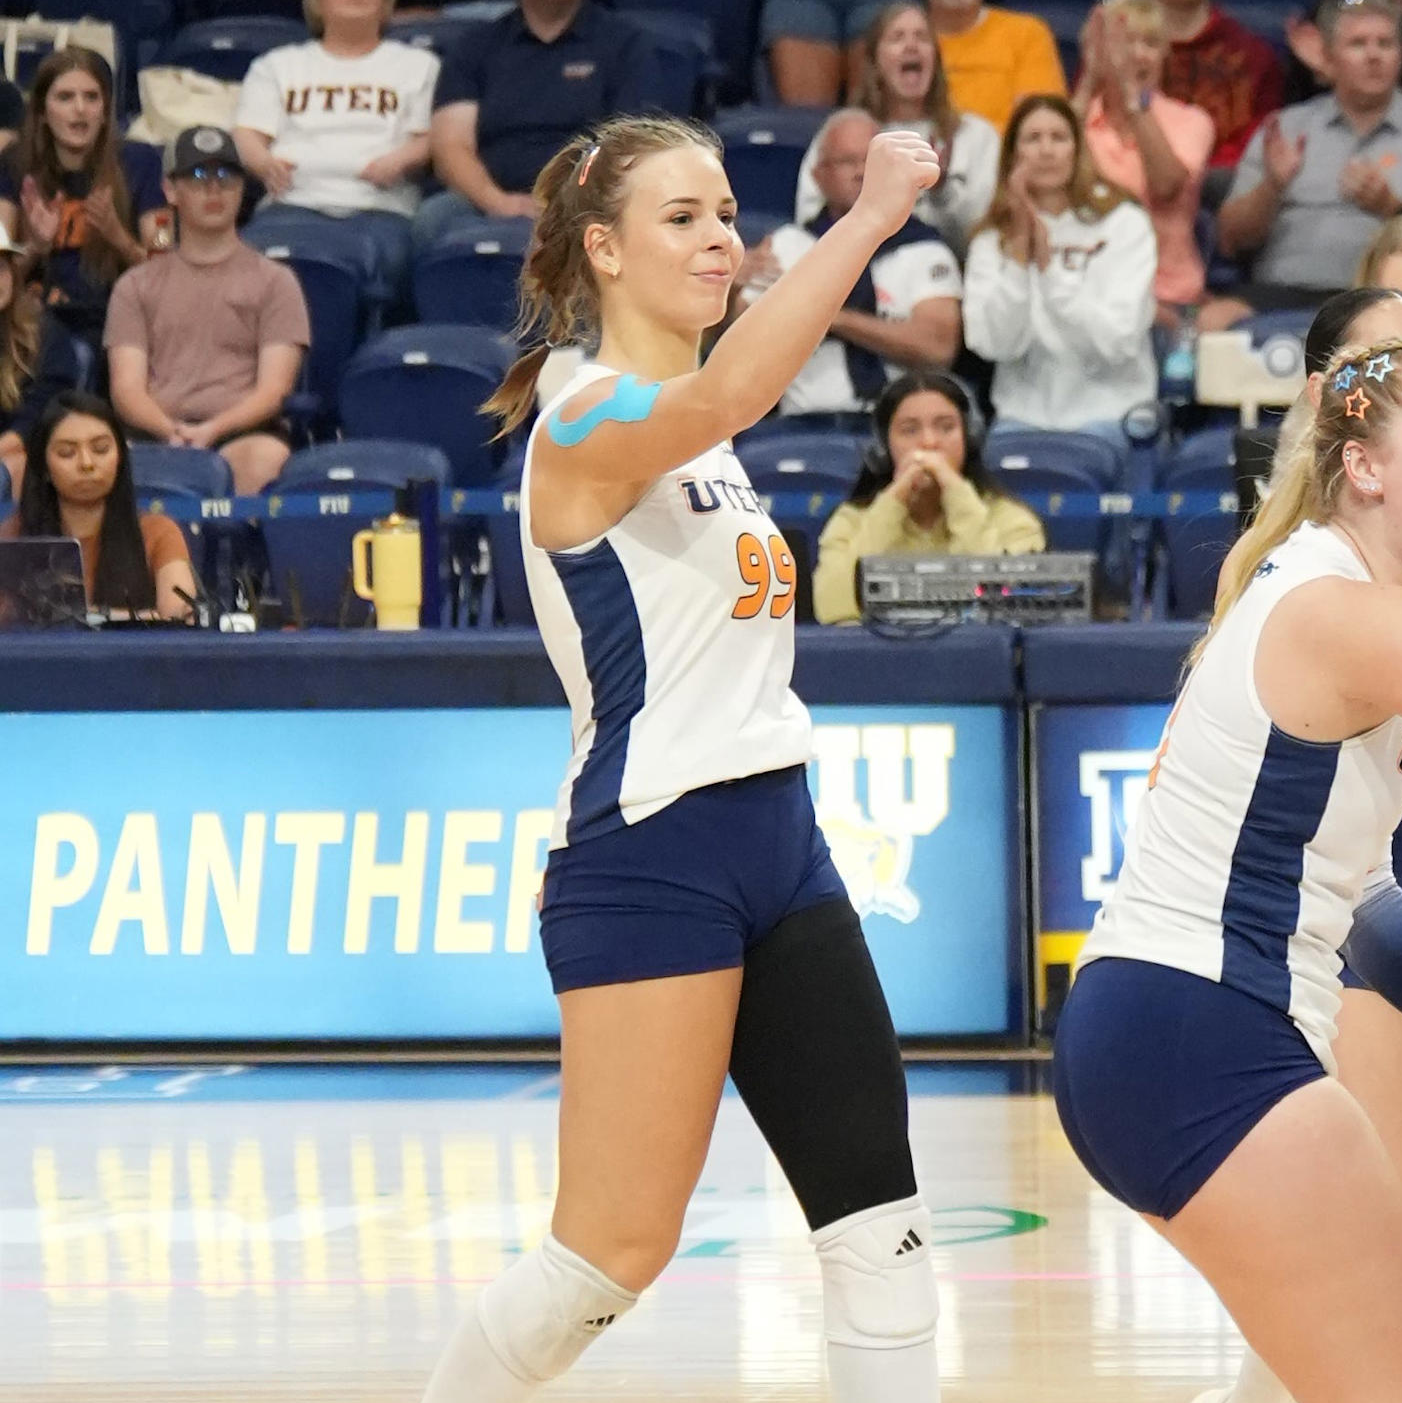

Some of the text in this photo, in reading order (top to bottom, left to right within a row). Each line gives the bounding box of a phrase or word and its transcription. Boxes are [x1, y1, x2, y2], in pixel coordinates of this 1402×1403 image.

[285, 84, 400, 116] UTEP
[201, 500, 232, 518] FIU
[319, 495, 350, 515] FIU
[732, 532, 797, 619] 99
